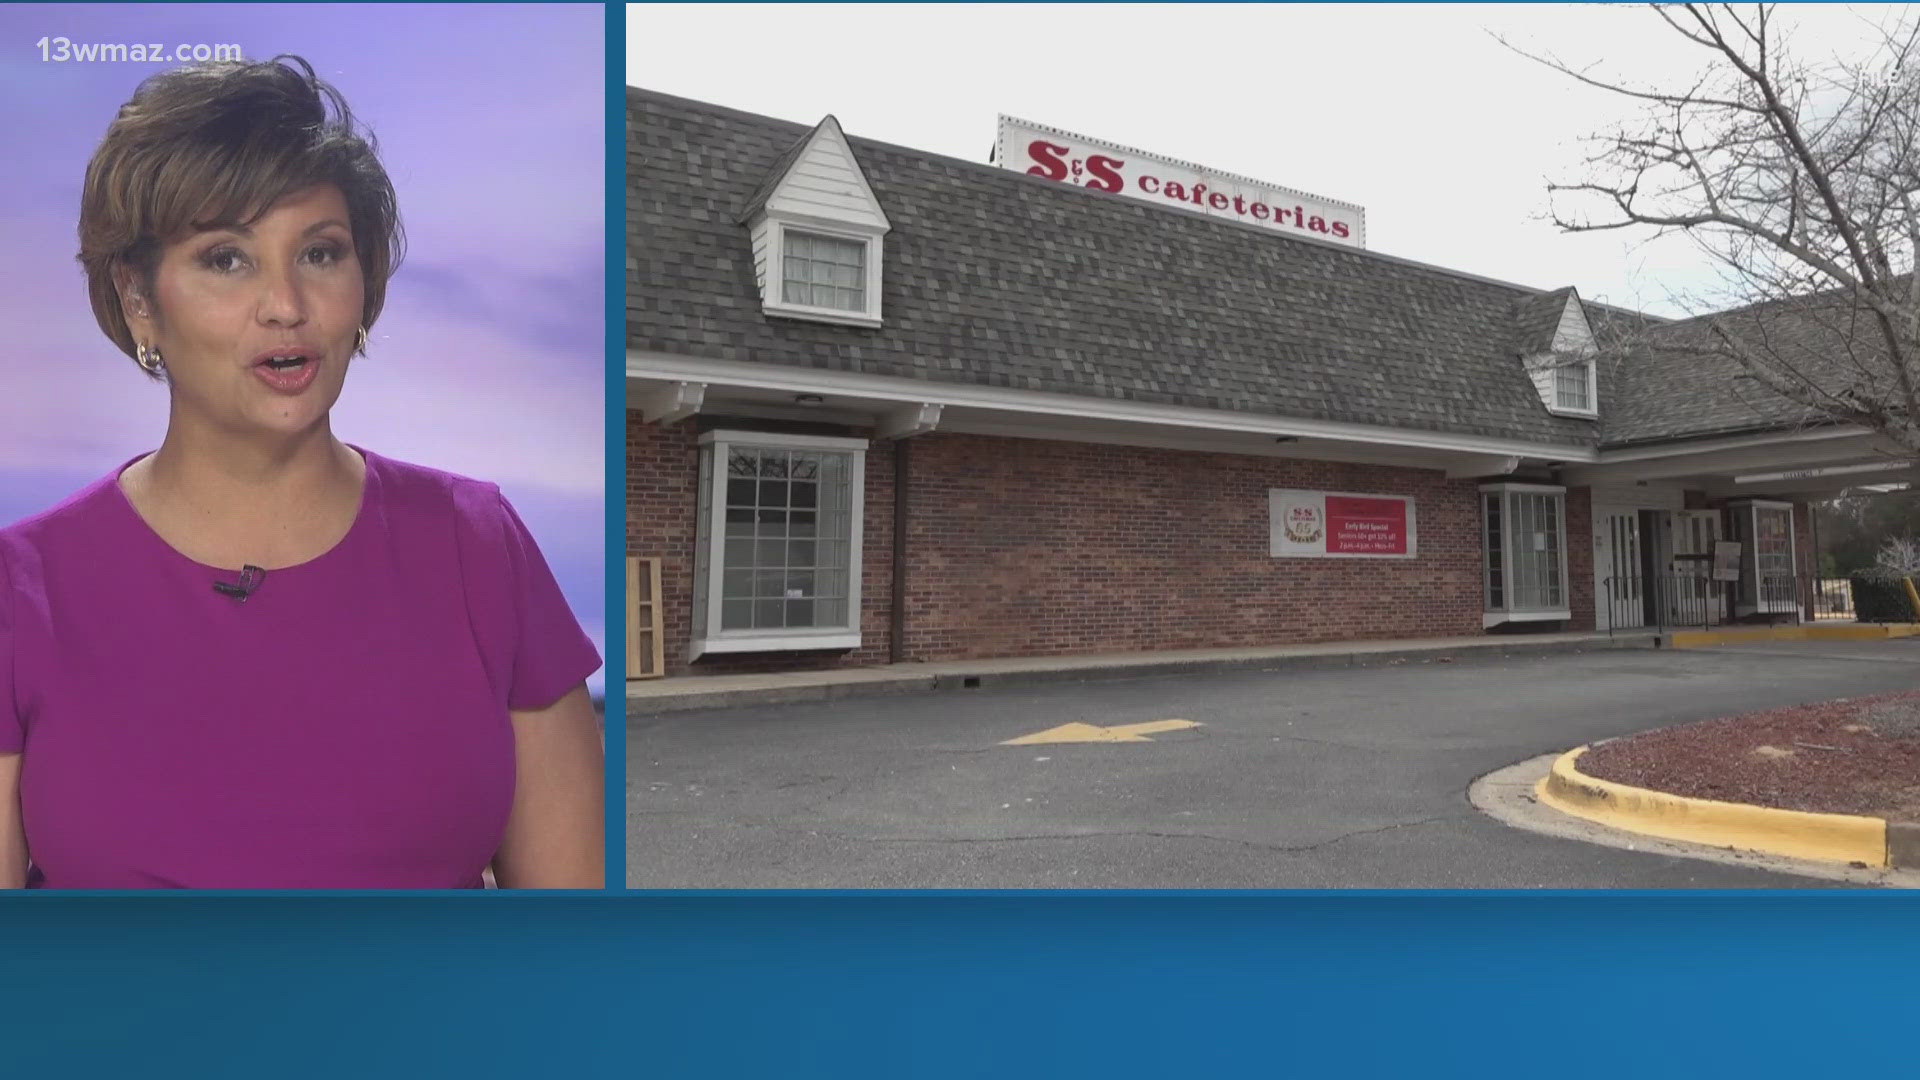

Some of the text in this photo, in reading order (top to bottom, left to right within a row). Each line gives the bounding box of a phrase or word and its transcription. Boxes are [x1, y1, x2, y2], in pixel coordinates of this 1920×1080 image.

[1026, 140, 1349, 239] S&S cafeterias
[1345, 522, 1389, 532] Early Bird Special
